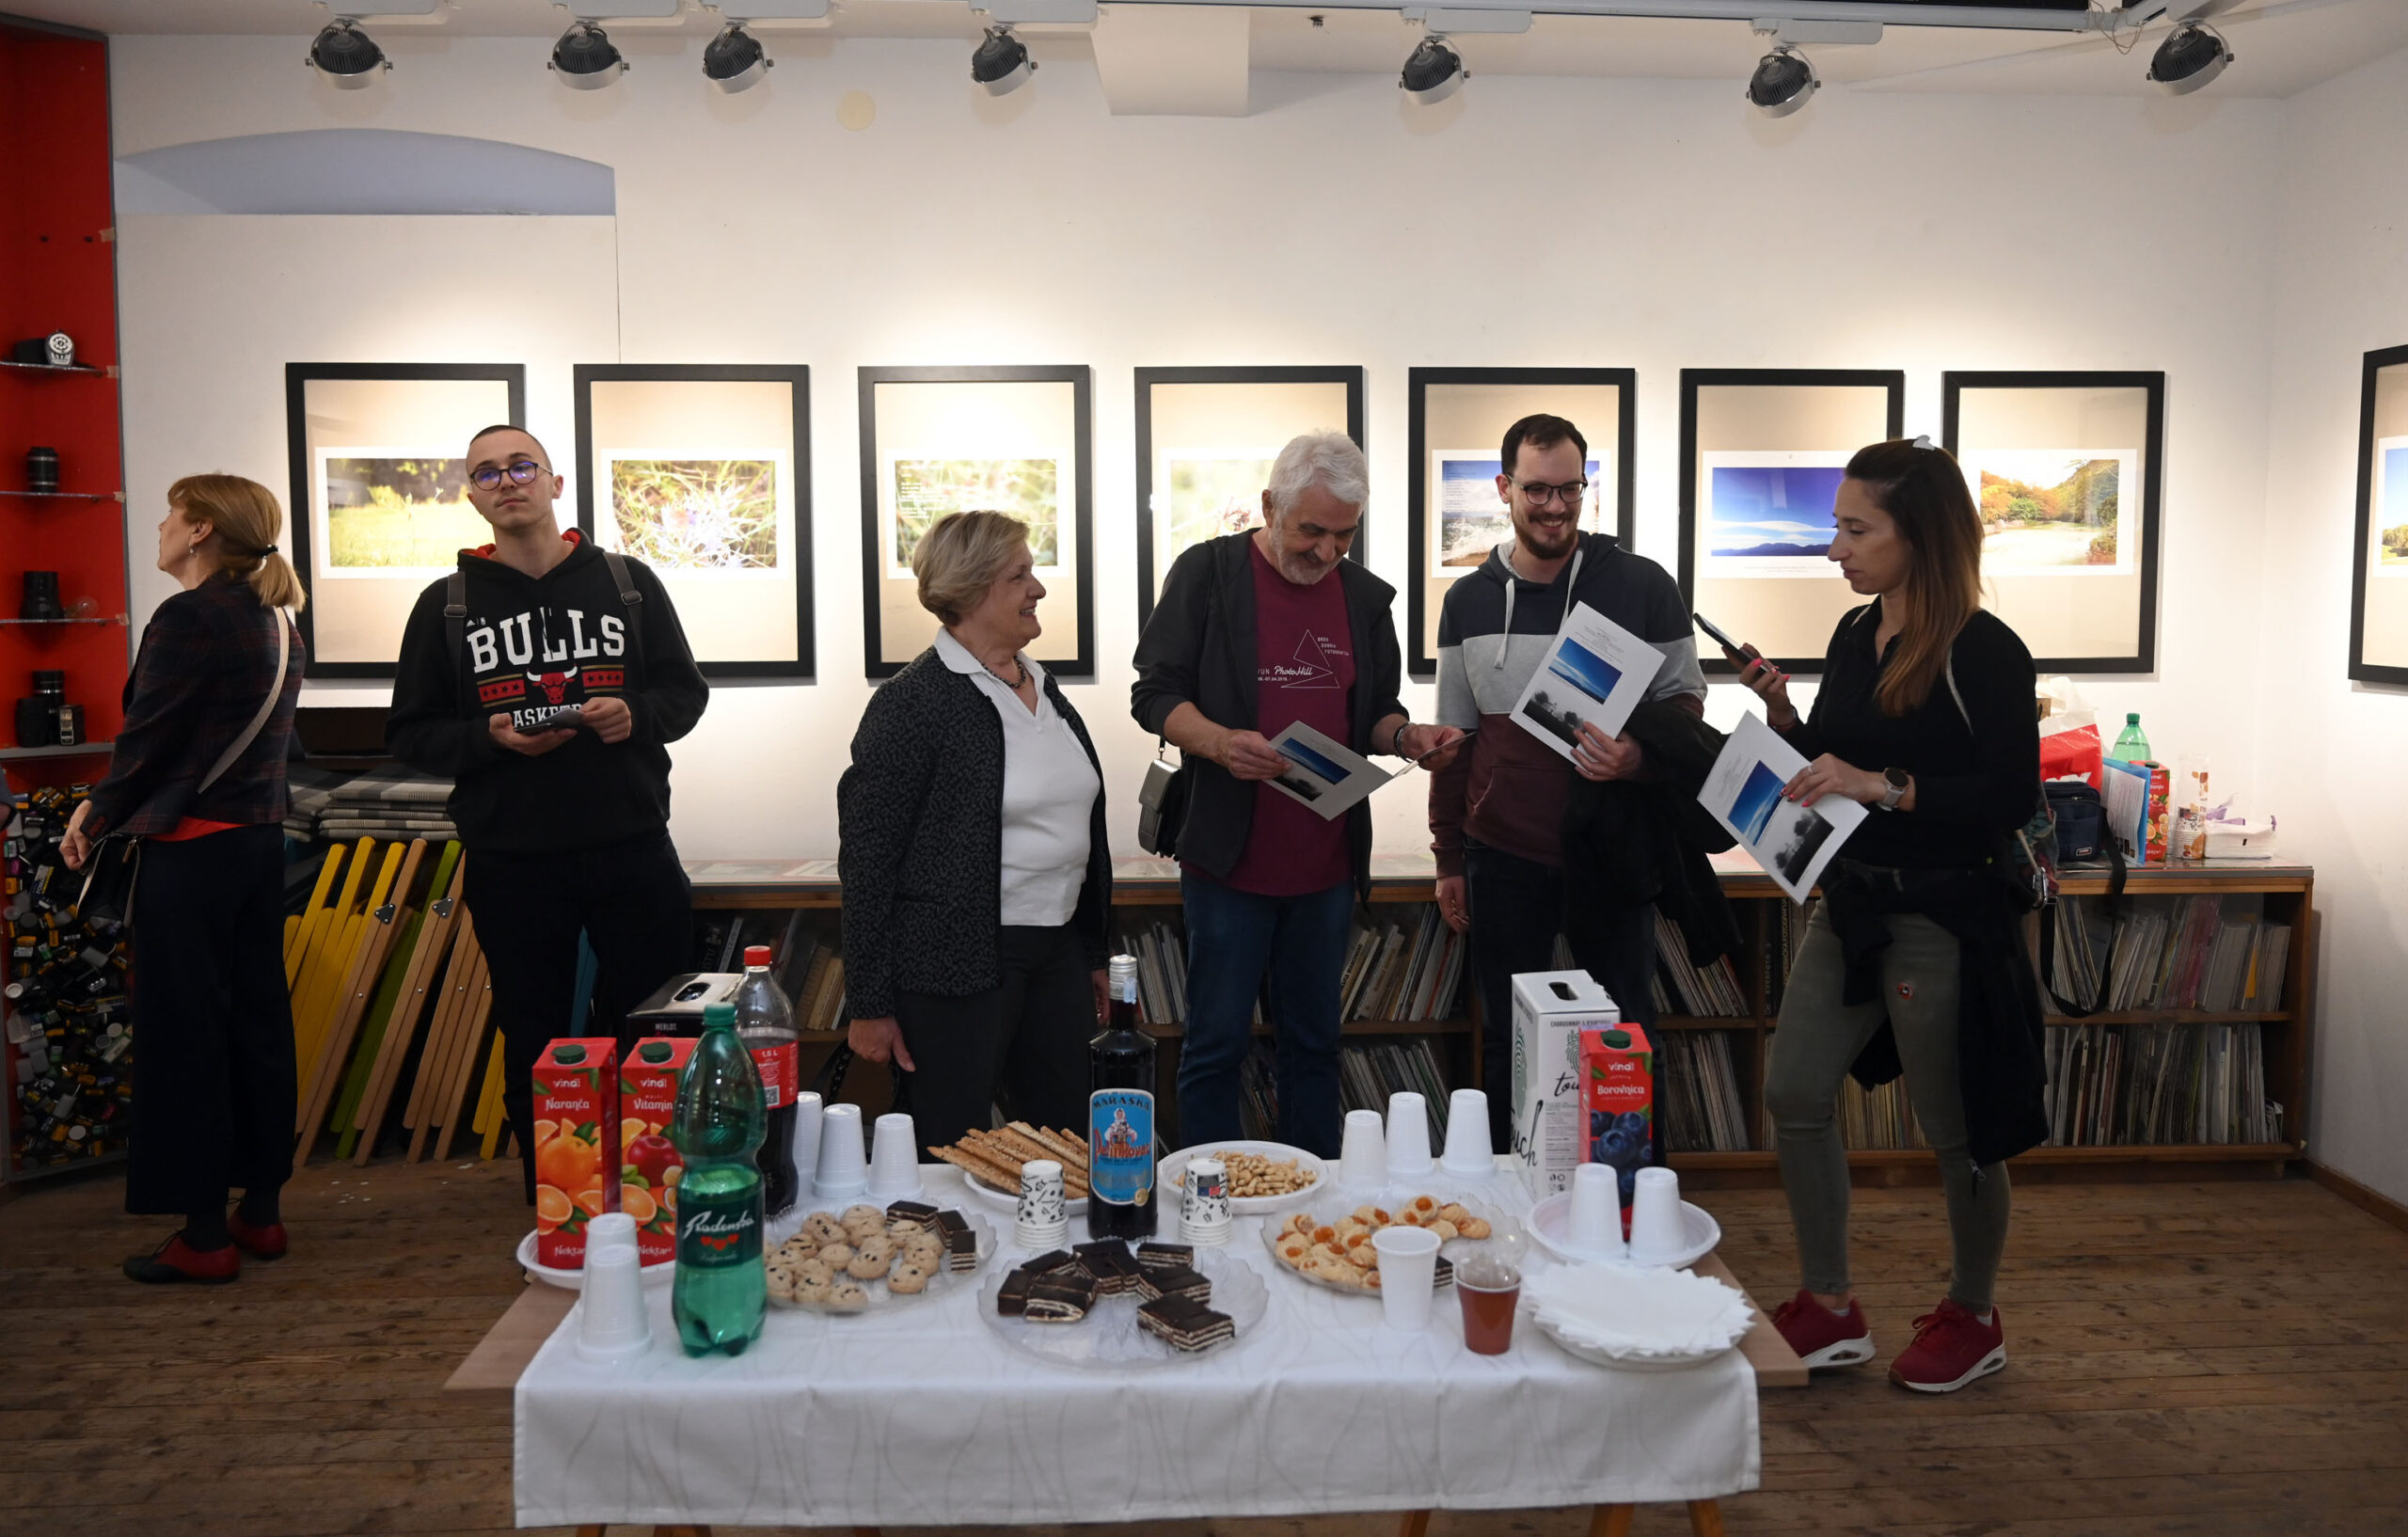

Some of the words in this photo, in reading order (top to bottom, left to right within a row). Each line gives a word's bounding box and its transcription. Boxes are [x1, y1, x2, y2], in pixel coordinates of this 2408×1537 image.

[467, 607, 625, 673] BULLS
[1608, 1062, 1635, 1071] vindi
[553, 1078, 581, 1088] vindi
[641, 1078, 668, 1088] vindi
[1597, 1085, 1645, 1096] Borovnica
[546, 1097, 591, 1111] Naranča
[634, 1098, 674, 1112] Vitamin
[1093, 1096, 1149, 1111] MARASKA
[1094, 1128, 1151, 1165] Pelinkovac
[683, 1210, 755, 1240] Radenska
